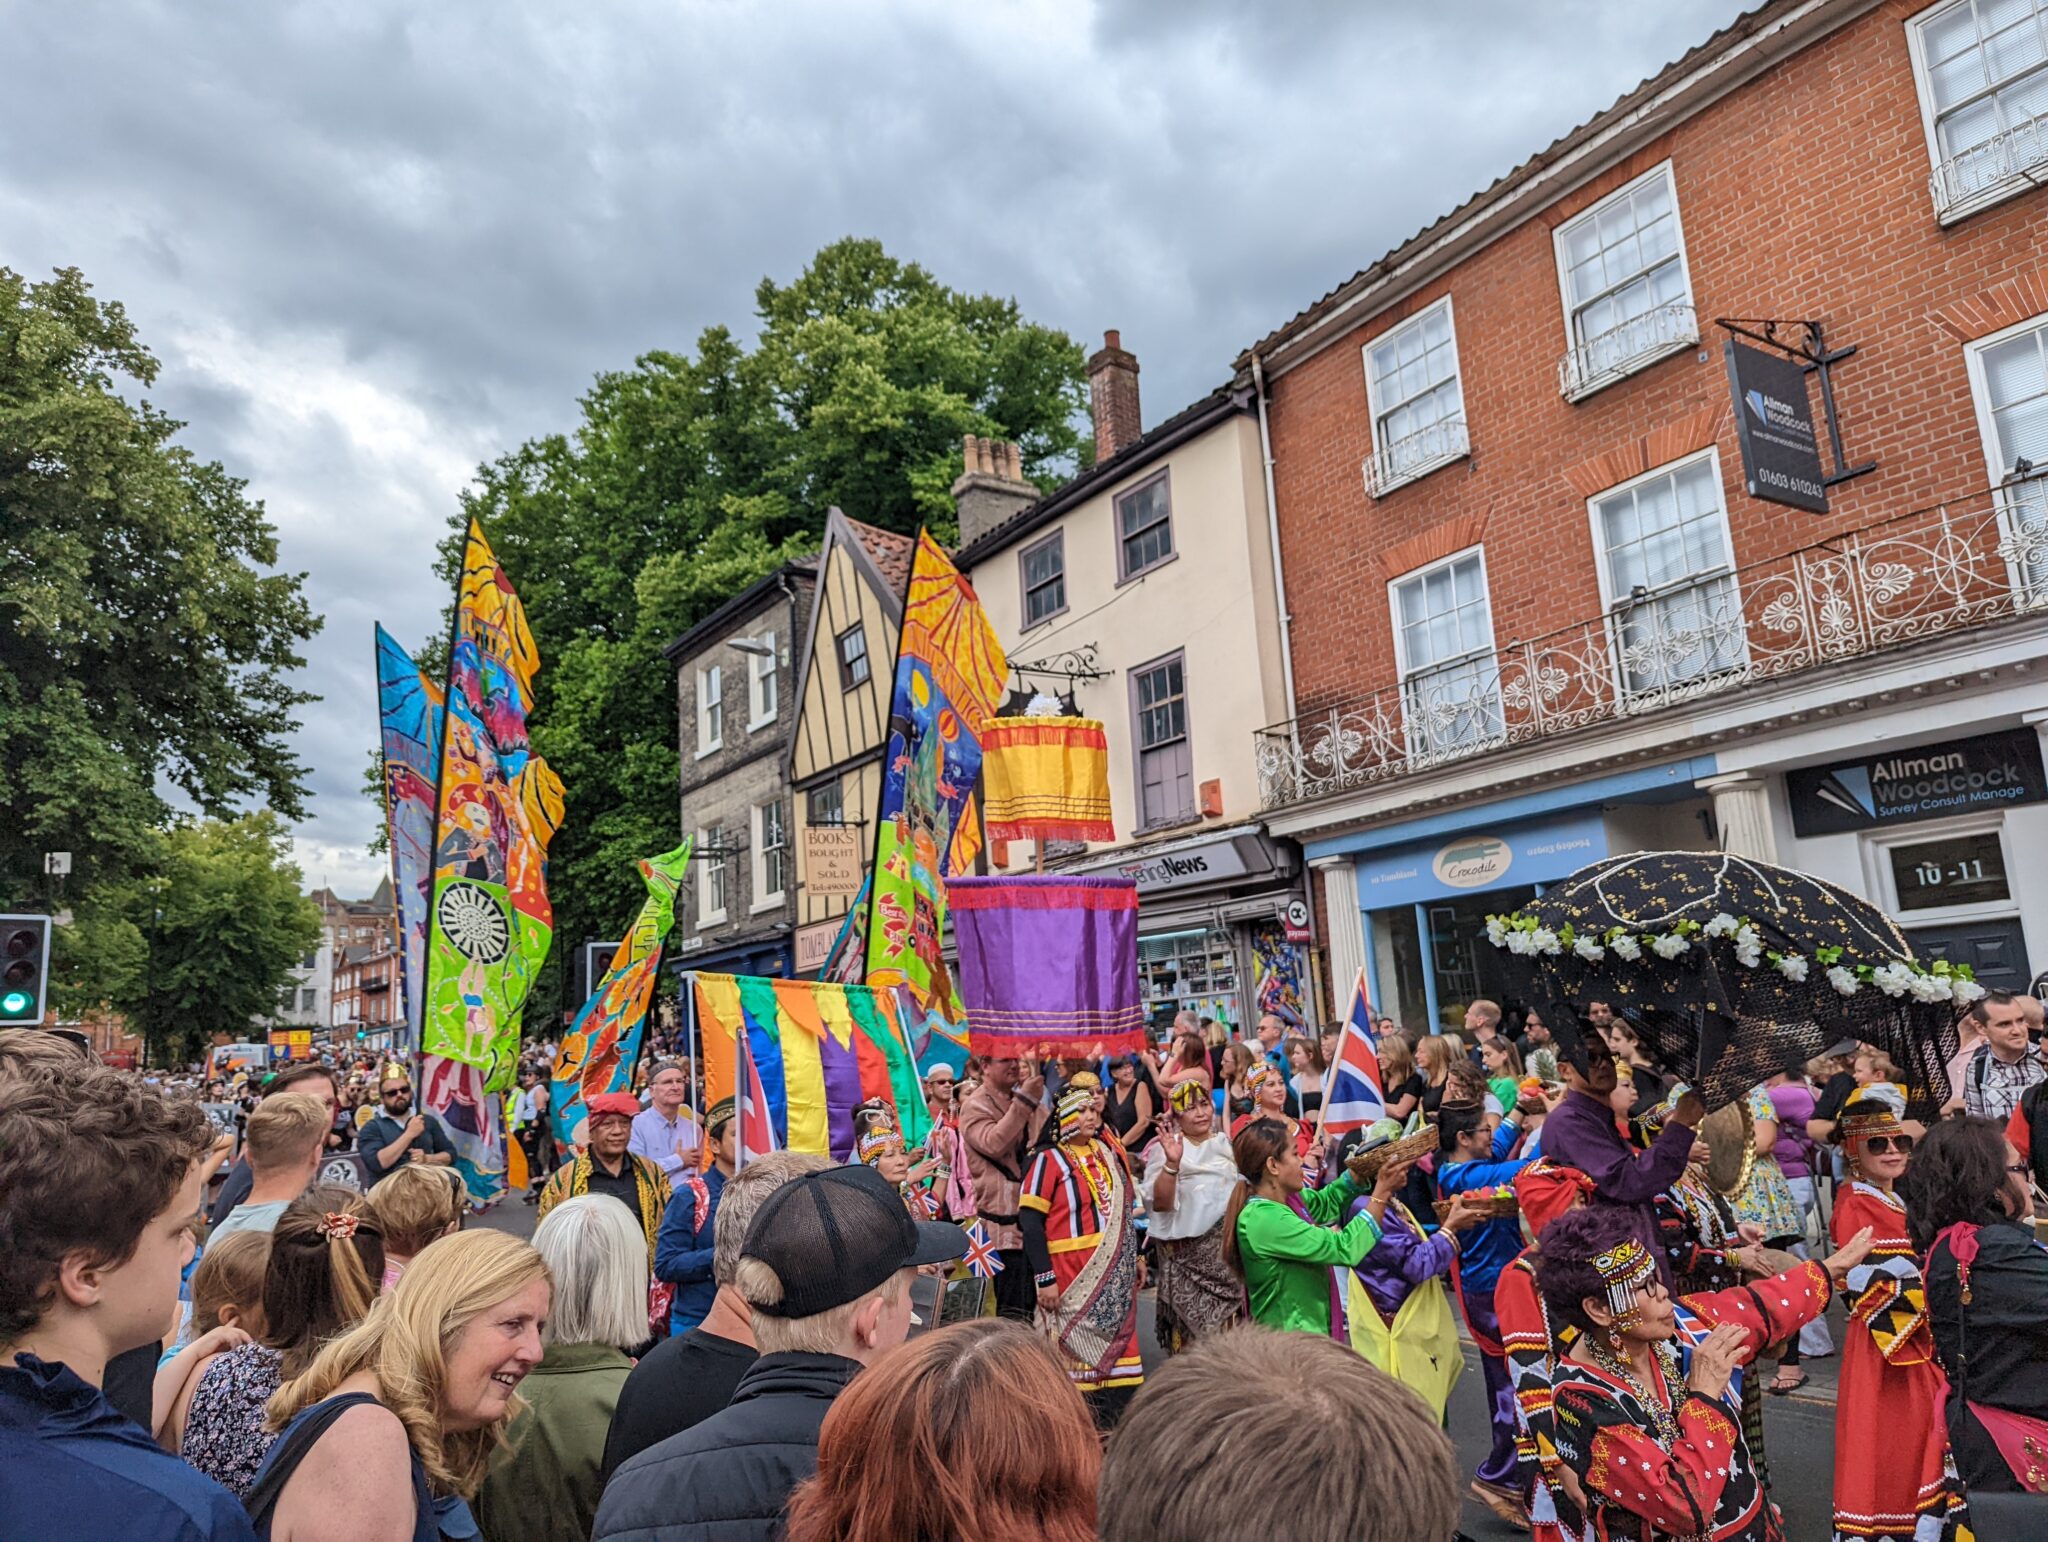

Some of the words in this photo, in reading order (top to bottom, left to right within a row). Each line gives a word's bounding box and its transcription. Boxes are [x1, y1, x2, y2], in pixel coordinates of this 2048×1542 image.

[1763, 395, 1794, 415] Allman
[1766, 408, 1812, 433] Woodcock
[1759, 468, 1789, 489] 01603
[1790, 477, 1823, 498] 610243
[1872, 752, 1963, 783] Allman
[1875, 763, 2020, 802] Woodcock
[1879, 803, 1918, 817] Survey
[1921, 794, 1966, 810] Consult
[1970, 785, 2025, 802] Manage
[808, 832, 855, 845] BOOKS
[808, 847, 854, 859] BOUGHT
[828, 860, 838, 868] &
[1448, 859, 1497, 879] Crocodile
[817, 870, 850, 879] SOLD
